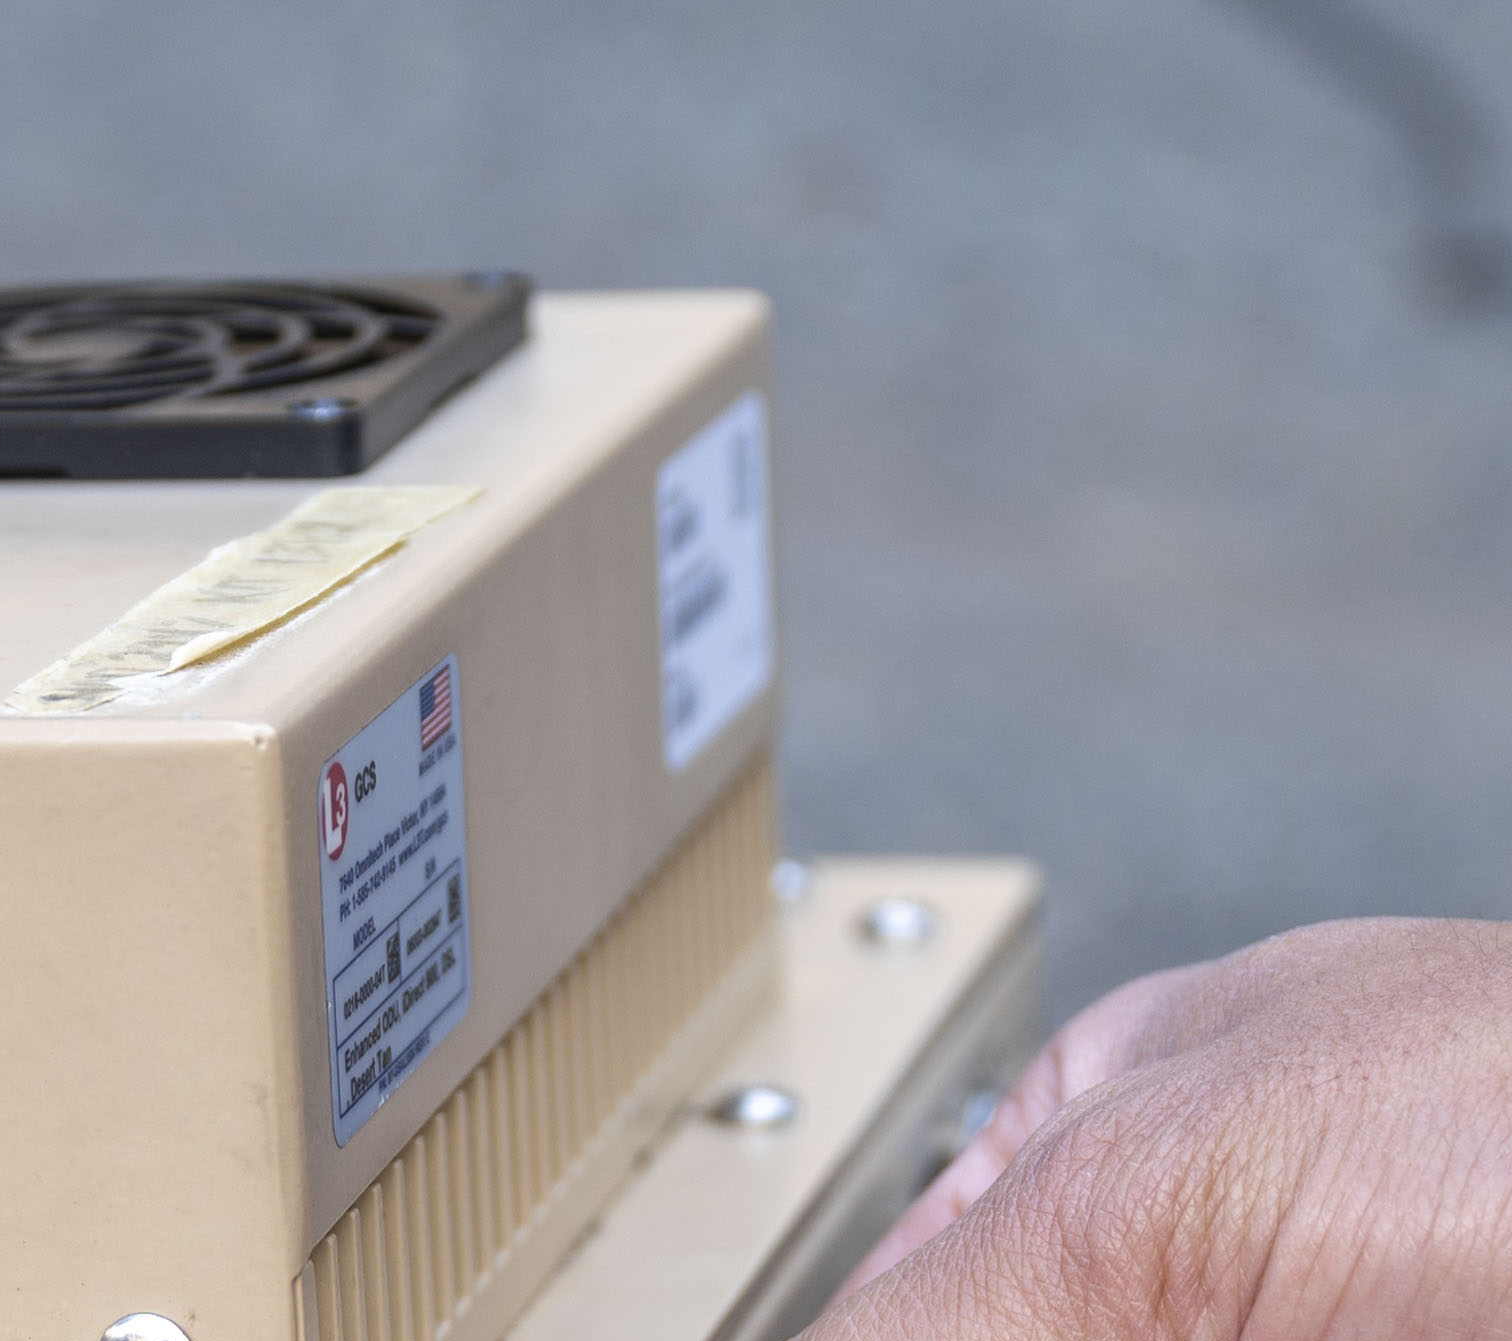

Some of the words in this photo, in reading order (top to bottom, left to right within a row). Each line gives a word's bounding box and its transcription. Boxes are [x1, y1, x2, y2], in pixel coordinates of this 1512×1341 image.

[354, 760, 376, 803] GCS
[384, 827, 400, 852] Place
[353, 915, 376, 952] MODEL
[344, 1017, 381, 1073] Enhanced
[377, 1045, 392, 1073] Tan
